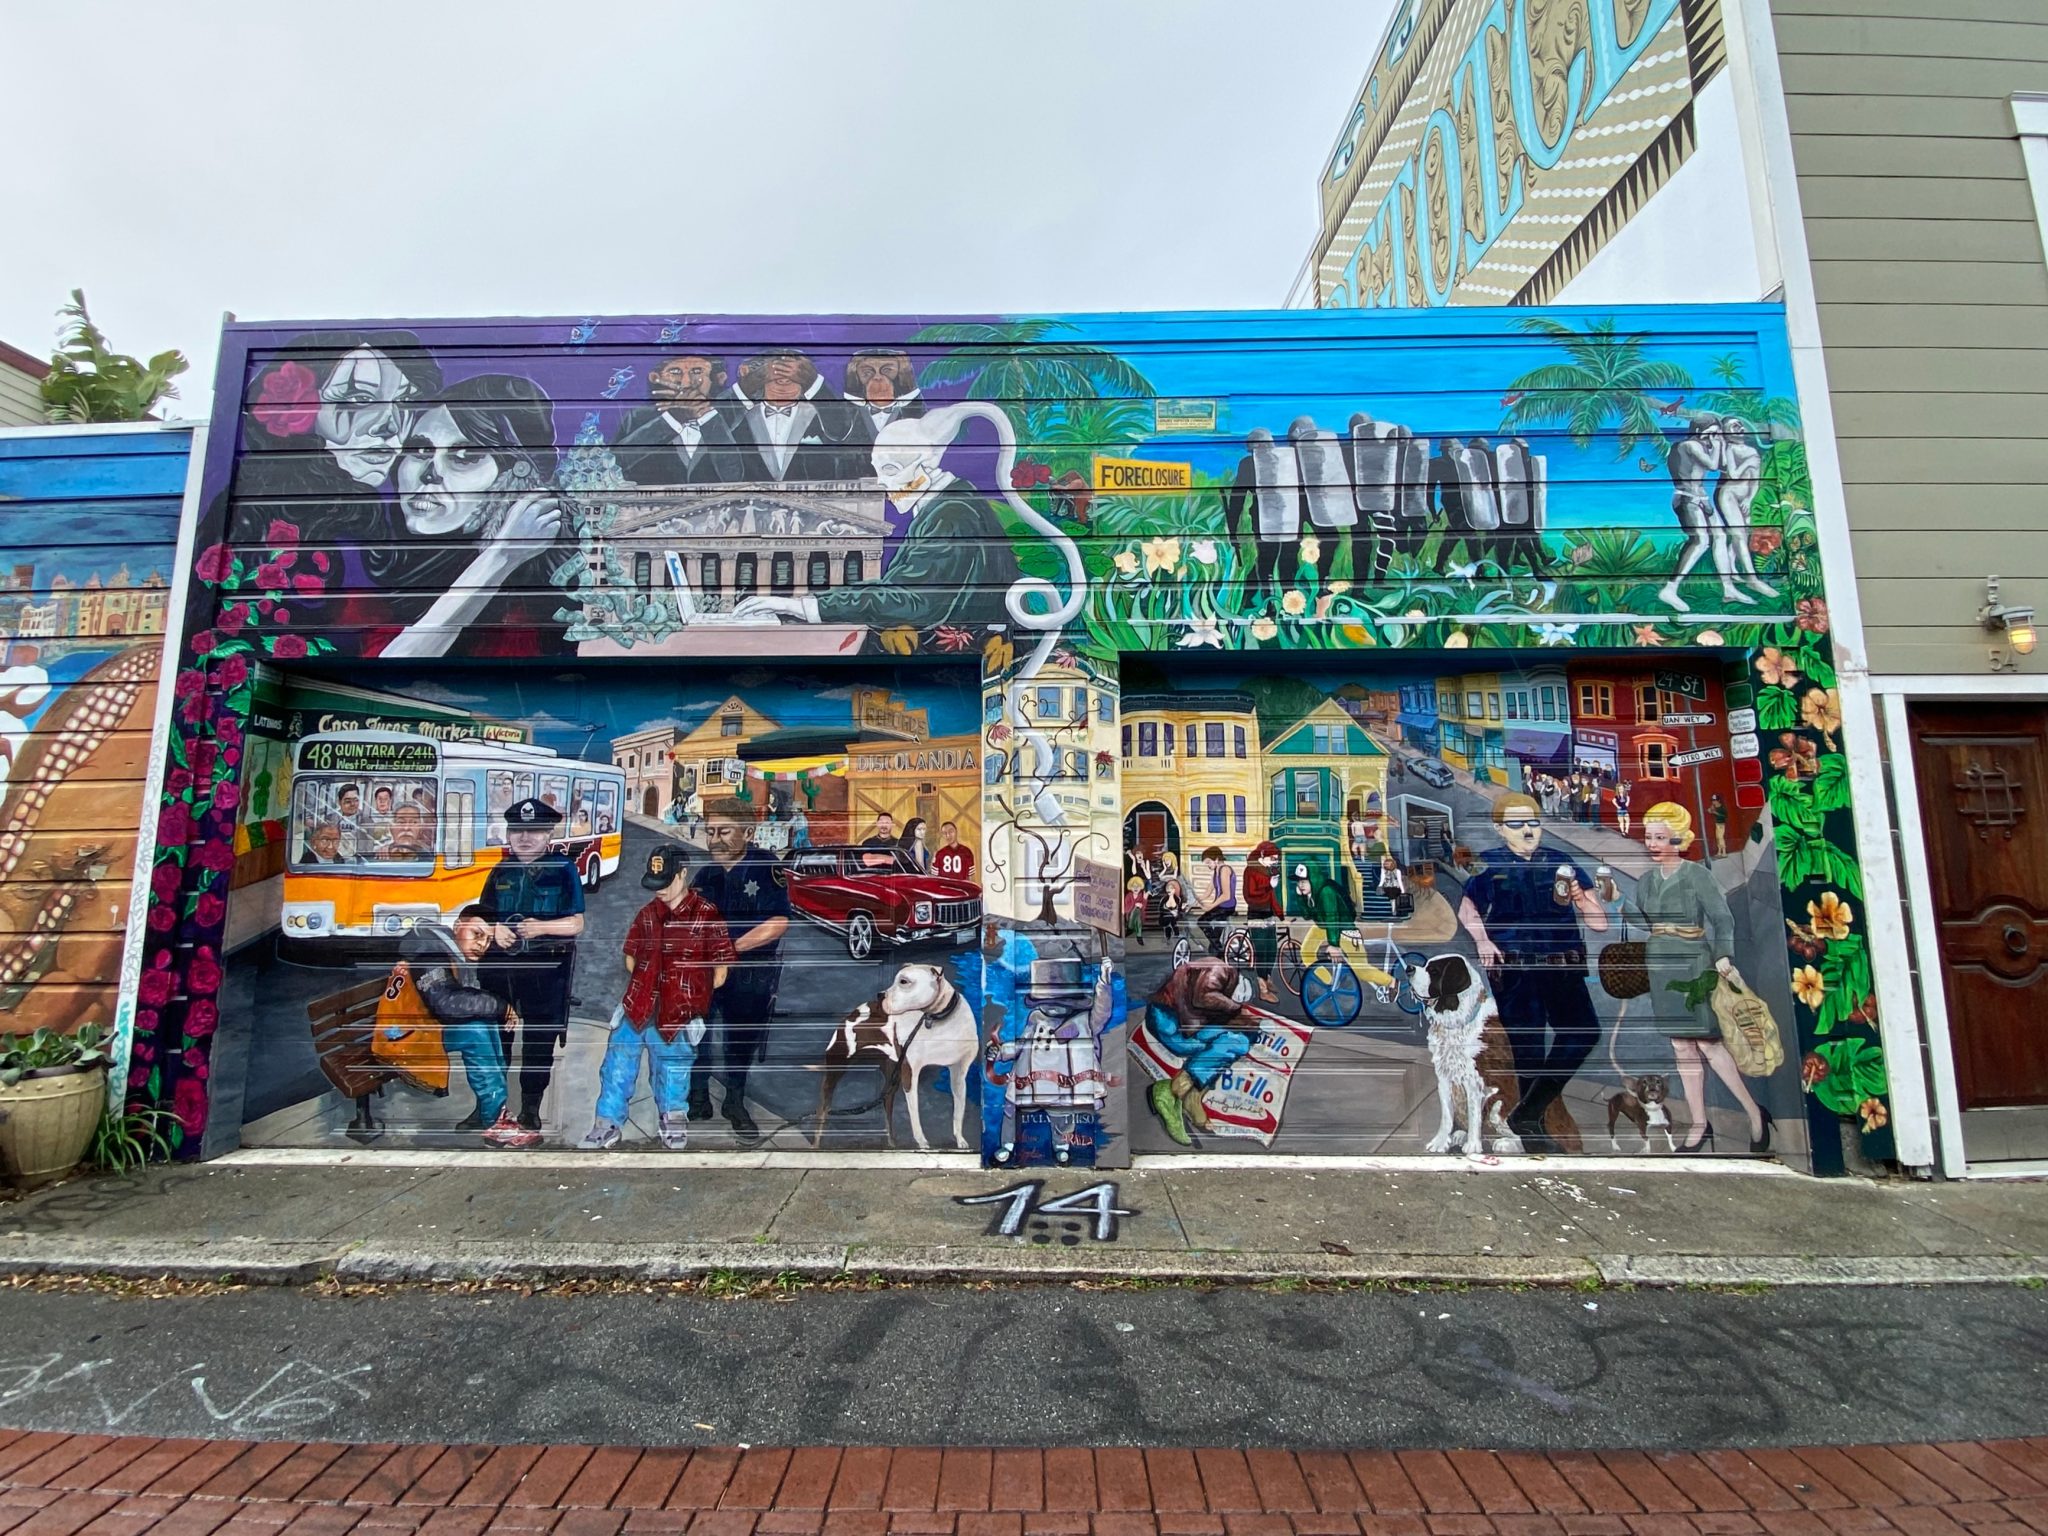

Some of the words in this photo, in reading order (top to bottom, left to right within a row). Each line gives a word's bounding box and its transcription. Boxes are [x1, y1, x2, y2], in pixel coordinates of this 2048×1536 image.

[1101, 465, 1187, 487] FORECLOSURE
[1681, 675, 1699, 695] St
[307, 743, 333, 770] 48
[335, 743, 396, 758] QUINTARA
[857, 748, 977, 773] DISCOLANDIA
[943, 855, 962, 874] 80
[1221, 1069, 1274, 1104] Brillo
